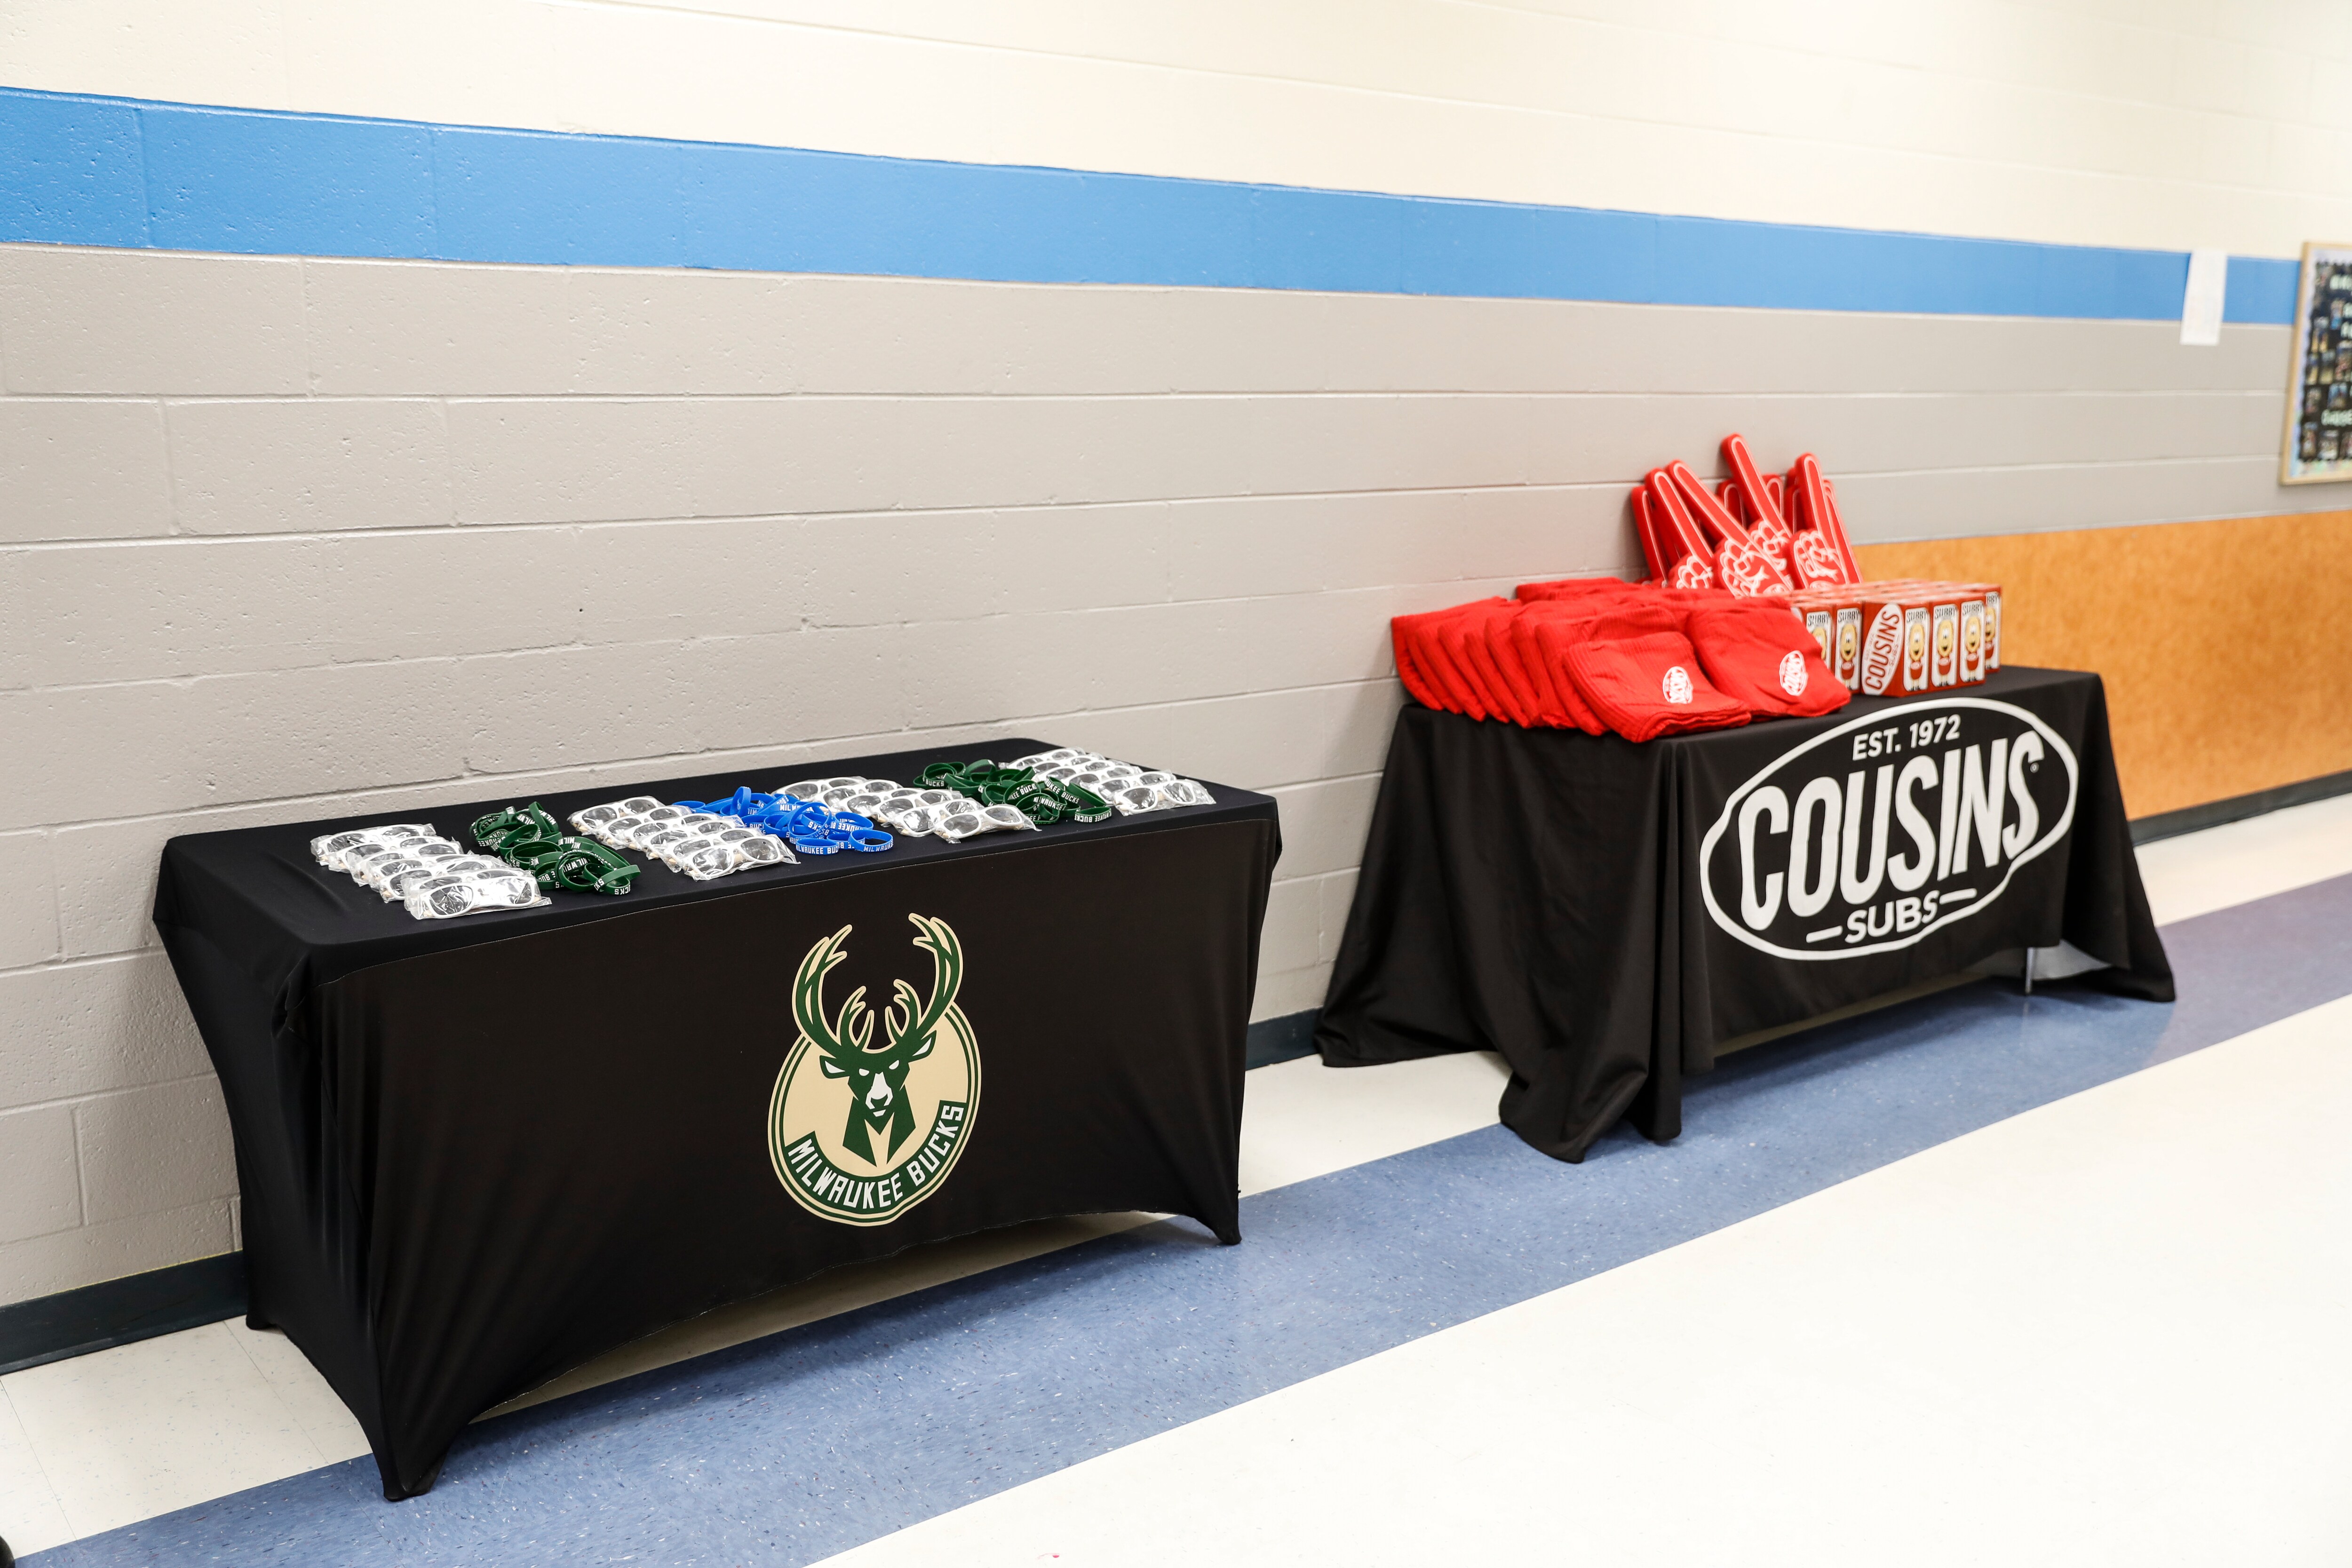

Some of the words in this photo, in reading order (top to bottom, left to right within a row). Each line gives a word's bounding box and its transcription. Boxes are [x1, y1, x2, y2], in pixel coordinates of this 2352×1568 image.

[1987, 594, 1998, 604] BBY
[1838, 611, 1860, 622] SUBBY
[1907, 611, 1928, 622] SUBBY
[1934, 607, 1956, 619] SUBBY
[1866, 612, 1899, 690] COUSINS
[1852, 728, 1901, 761] EST.
[1909, 714, 1961, 749] 1972
[1061, 792, 1080, 804] BUCKS
[1074, 814, 1092, 823] BUCKS
[1738, 730, 2044, 931] COUSINS
[1844, 889, 1941, 943] SUBS
[787, 1138, 903, 1210] MILWAUKEE
[906, 1104, 964, 1186] BUCKS
